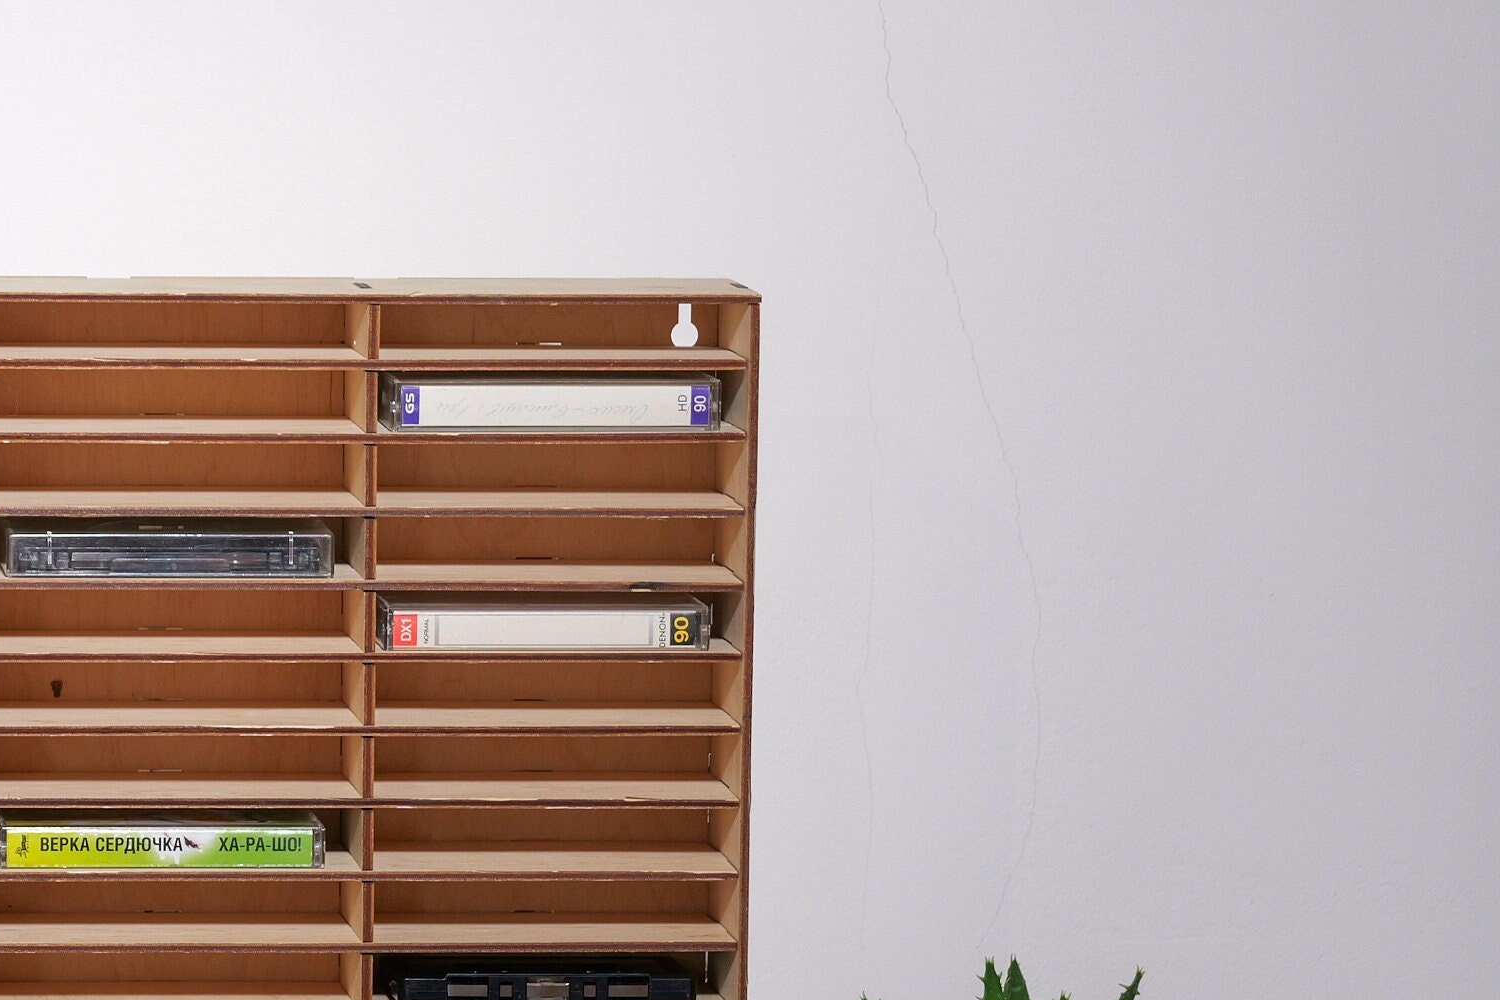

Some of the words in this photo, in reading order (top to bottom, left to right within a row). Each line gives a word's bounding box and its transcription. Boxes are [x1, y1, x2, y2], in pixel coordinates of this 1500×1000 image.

[404, 392, 415, 414] GS
[677, 394, 688, 412] HD
[693, 395, 706, 413] 90
[400, 617, 412, 642] DX1
[658, 616, 667, 648] DENON
[674, 615, 690, 643] 90
[40, 836, 90, 852] ВЕРКА
[95, 836, 184, 855] СЕРДЮЧКА
[218, 836, 303, 852] ХА-РА-ШО!
